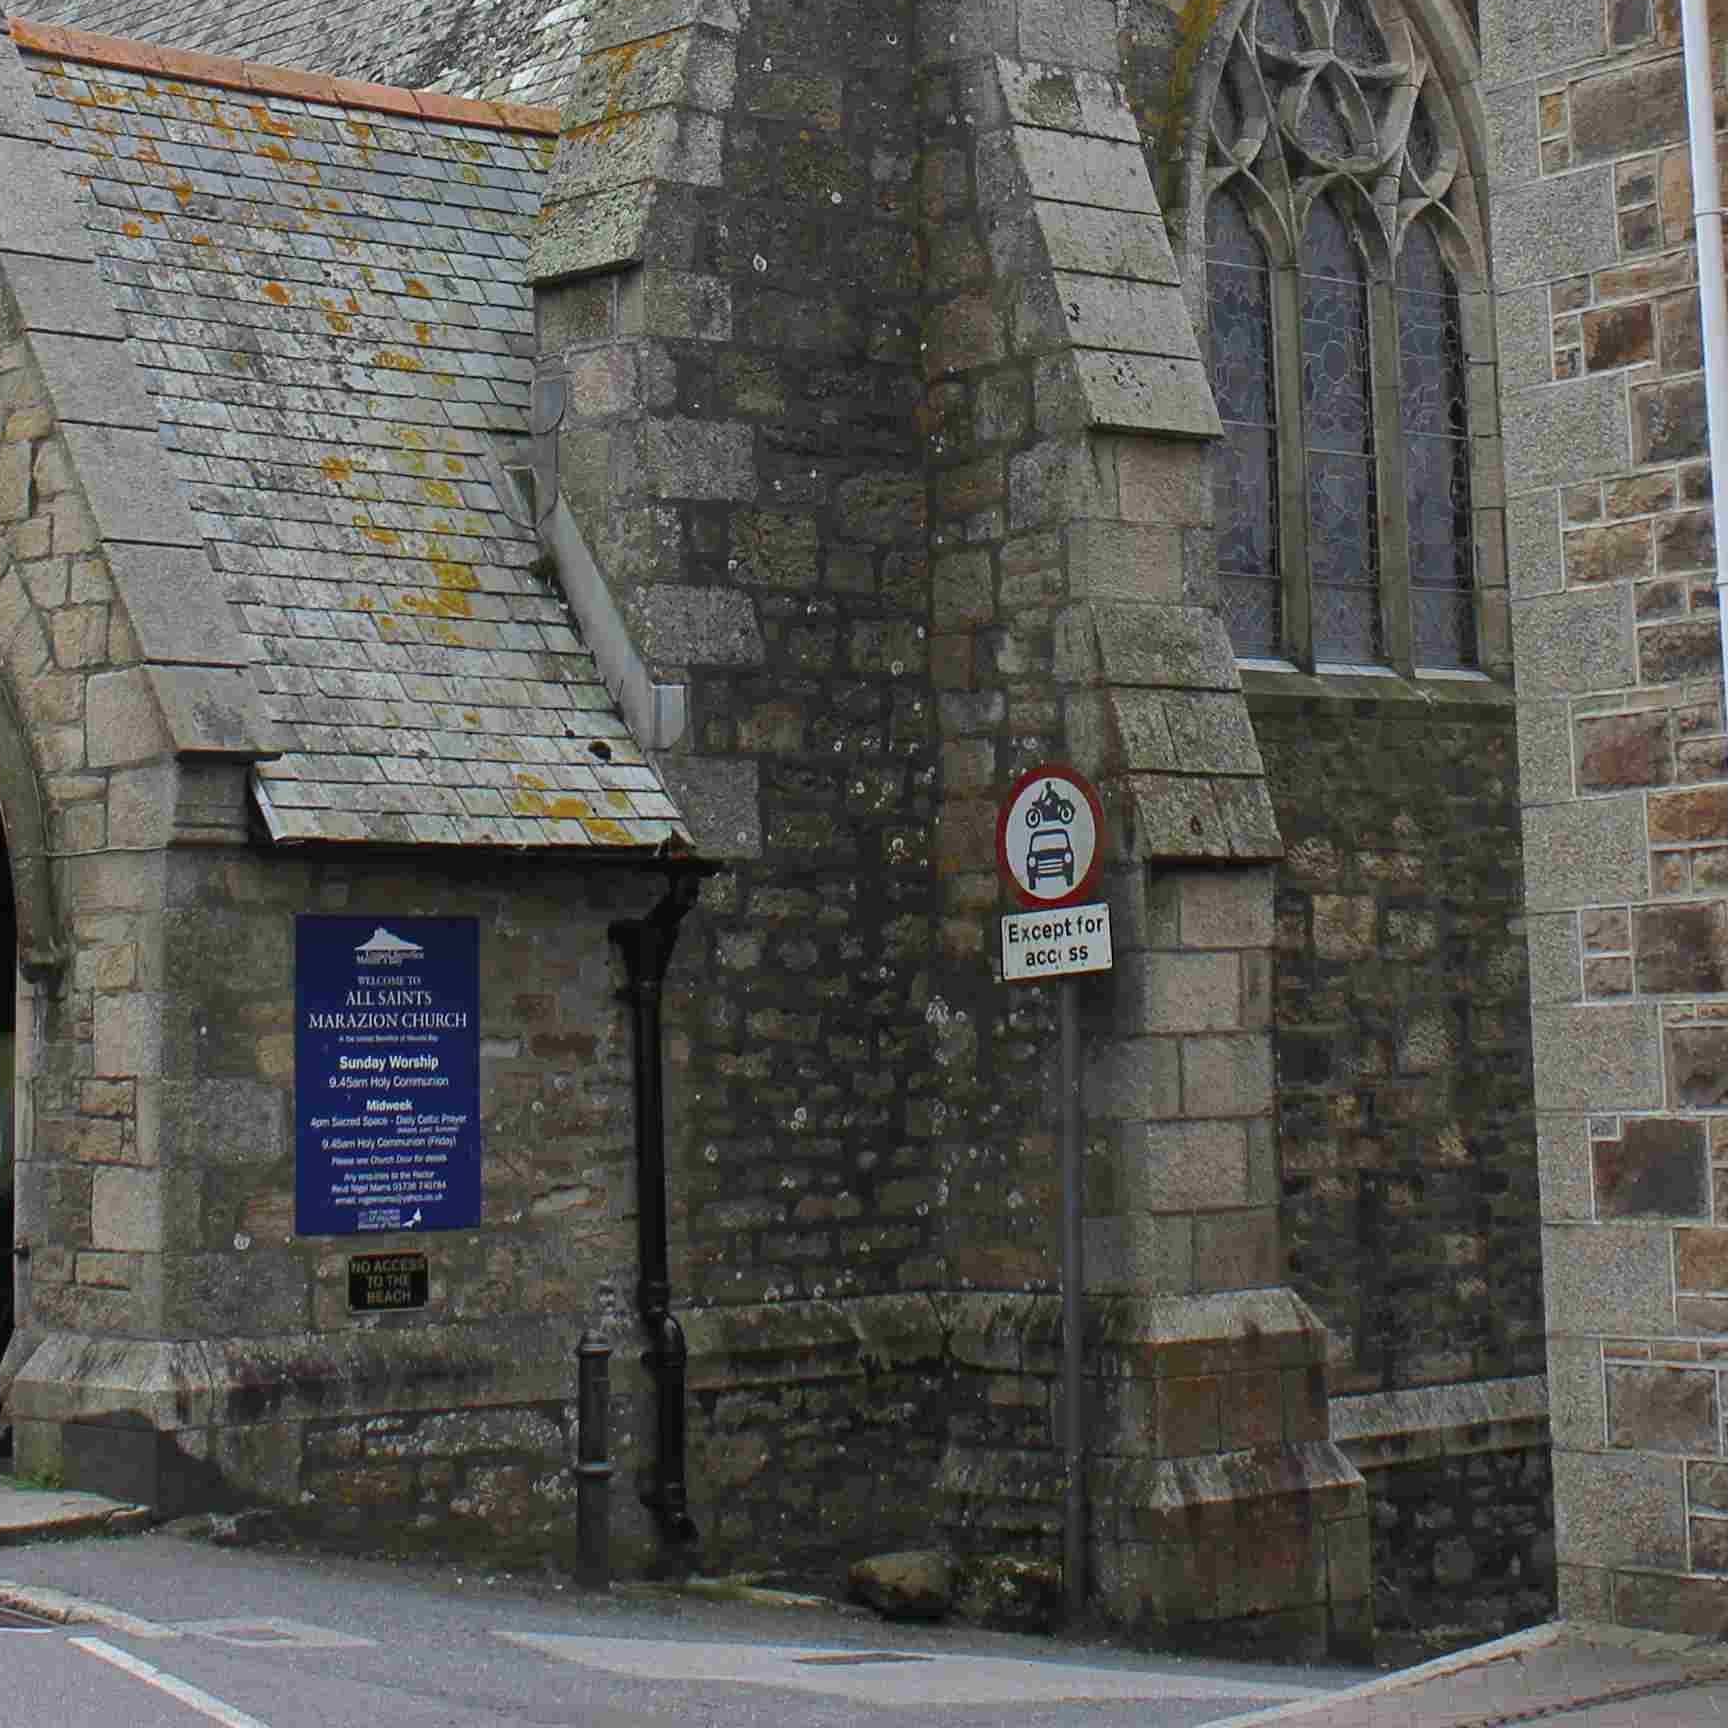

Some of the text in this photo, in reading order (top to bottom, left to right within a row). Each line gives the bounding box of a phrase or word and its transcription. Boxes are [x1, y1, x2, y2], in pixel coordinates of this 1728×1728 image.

[1008, 915, 1103, 944] Except for
[357, 975, 421, 986] WELCOME TO
[345, 990, 432, 1006] ALL SAINTS
[308, 1012, 467, 1029] MARAZION CHURCH
[339, 1054, 439, 1071] Sunday Worship
[328, 1075, 449, 1091] 9.45am Holy Communion
[366, 1099, 413, 1112] Midweek
[357, 1138, 375, 1151] Holy
[377, 1137, 426, 1149] Communion
[351, 1256, 425, 1273] NO ACCESS
[368, 1275, 384, 1288] TO
[367, 1288, 411, 1304] BEACH
